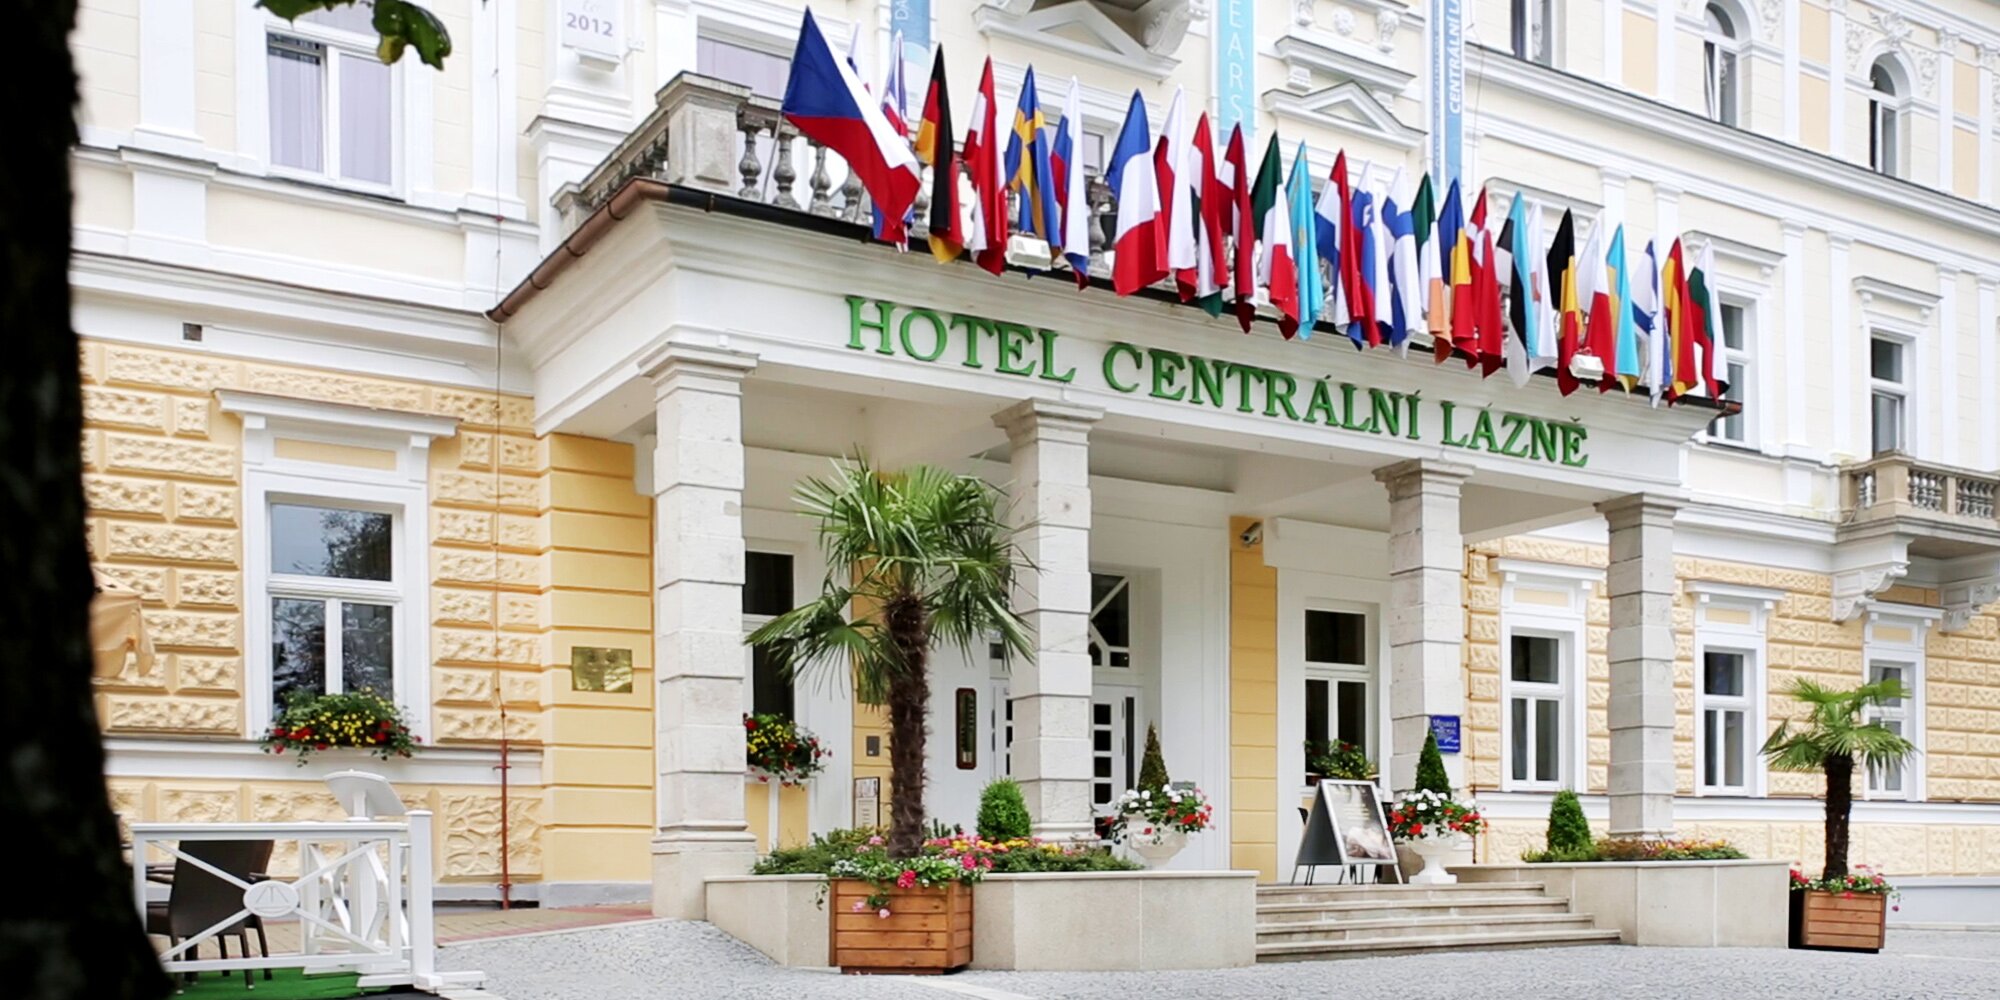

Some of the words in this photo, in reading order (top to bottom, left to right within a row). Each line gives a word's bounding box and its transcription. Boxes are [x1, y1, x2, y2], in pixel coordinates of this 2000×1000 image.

[567, 12, 613, 37] 2012
[1227, 0, 1245, 122] EARS
[1446, 14, 1460, 114] CENTRÁLNÍ
[845, 295, 1076, 383] HOTEL
[1102, 341, 1422, 440] CENTRÁLNÍ
[1440, 400, 1589, 467] LÁZNĚ
